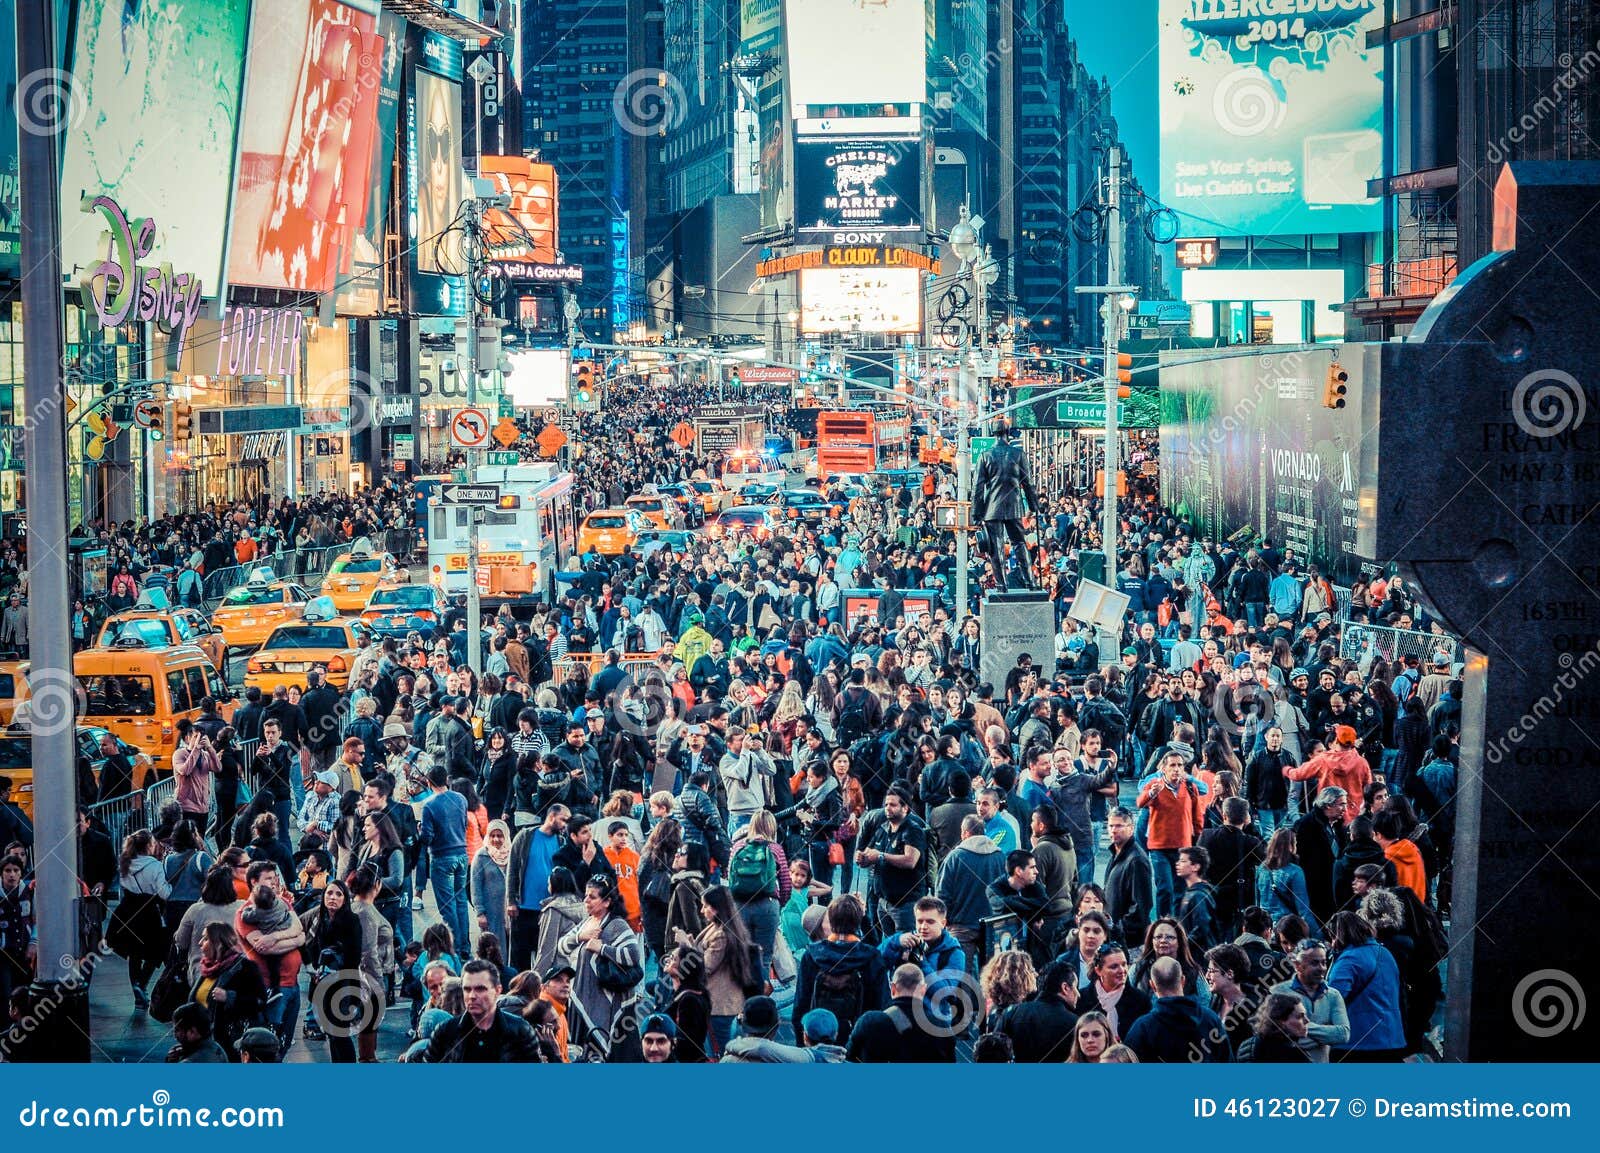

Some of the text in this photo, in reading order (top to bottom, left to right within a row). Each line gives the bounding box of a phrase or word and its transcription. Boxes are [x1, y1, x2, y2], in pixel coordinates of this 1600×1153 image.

[1248, 18, 1307, 42] 2014
[825, 151, 897, 167] CHELSEA
[1175, 161, 1209, 177] Save
[1211, 160, 1244, 176] Your
[1175, 182, 1203, 197] Live
[825, 195, 898, 208] MARKET
[833, 232, 887, 244] SONY
[1130, 316, 1137, 327] W
[1139, 316, 1148, 327] 46
[216, 306, 302, 376] FOREVER
[743, 368, 792, 380] Walgreens
[701, 408, 737, 417] nuchas
[1067, 406, 1108, 418] Broadwa
[1483, 422, 1600, 453] FRANC
[240, 434, 277, 461] FOREVER
[489, 452, 516, 465] W 46 ST
[1270, 448, 1321, 482] VORNADO
[456, 490, 494, 499] ONE WAY
